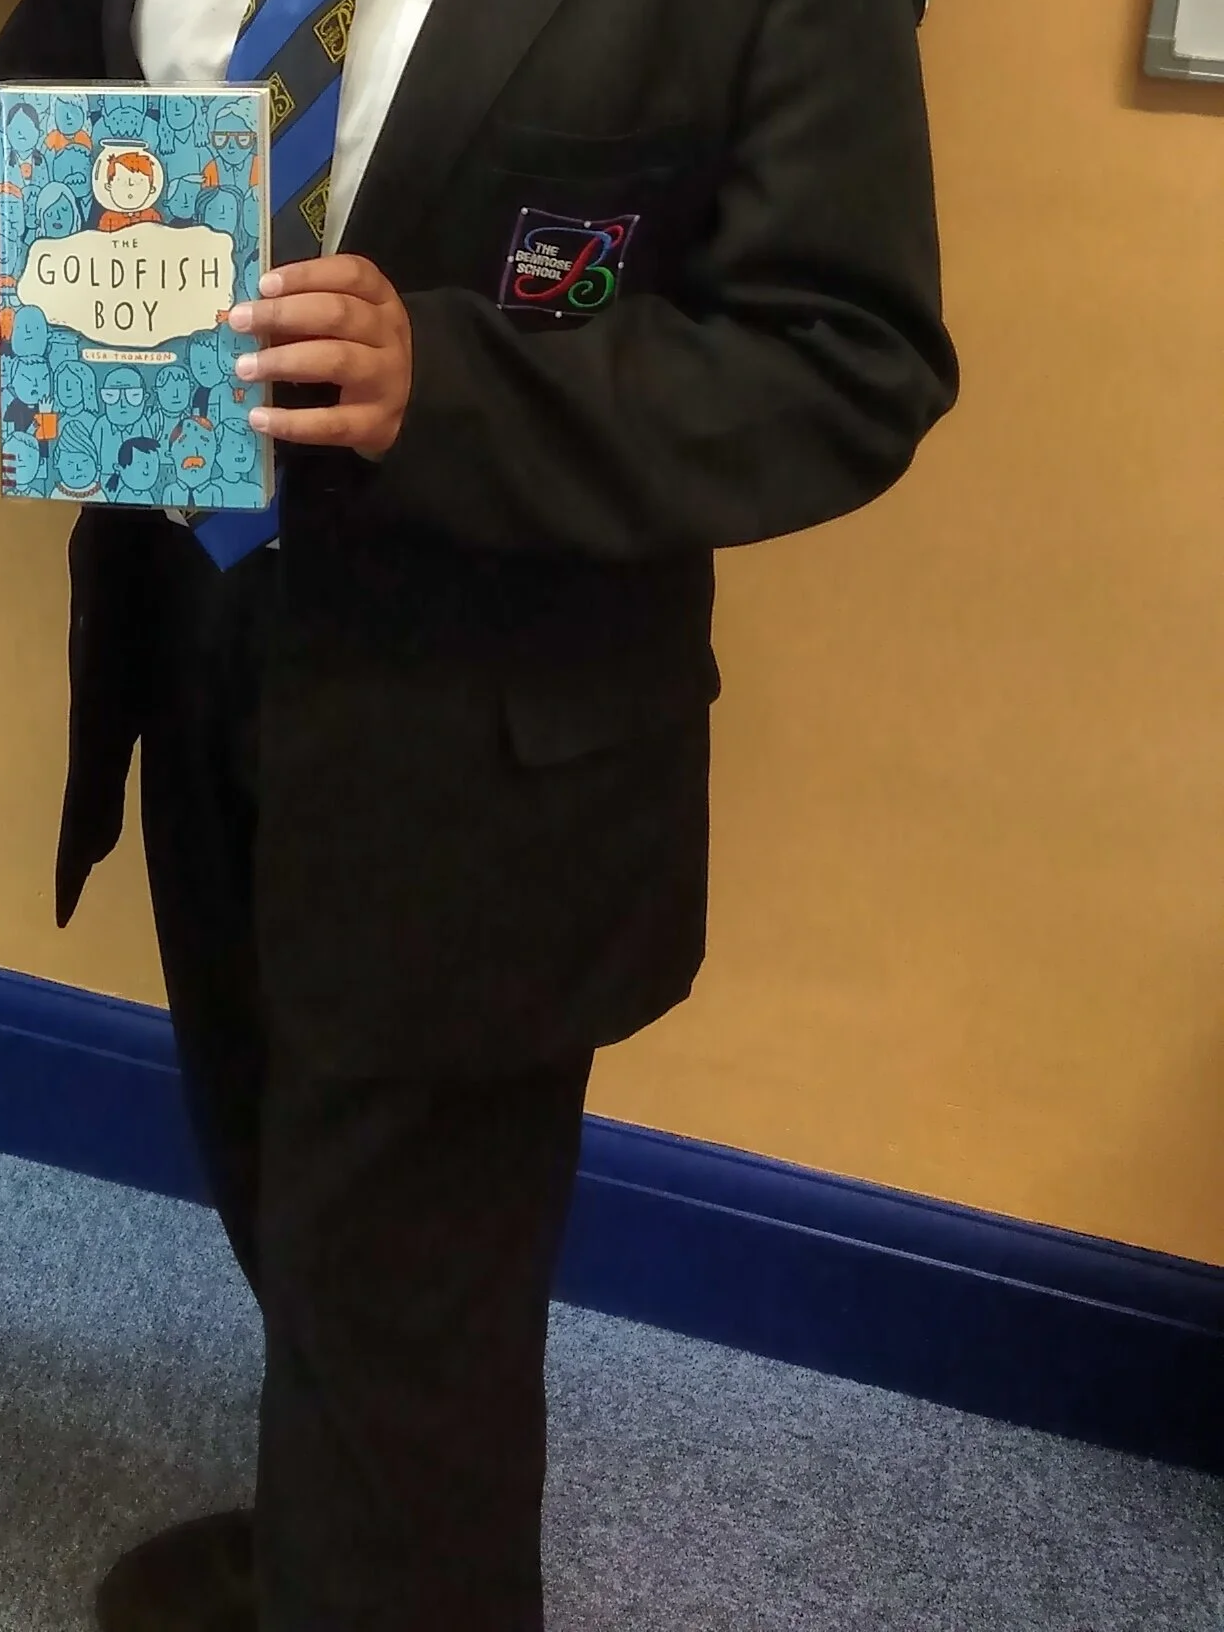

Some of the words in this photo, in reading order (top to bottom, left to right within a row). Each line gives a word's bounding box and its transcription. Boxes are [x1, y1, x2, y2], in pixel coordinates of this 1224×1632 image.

[111, 238, 139, 249] THE
[534, 241, 560, 257] THE
[515, 250, 573, 272] BEMROSE
[36, 253, 220, 290] GOLDFISH
[516, 263, 563, 281] SCHOOL
[94, 300, 159, 332] BOY
[85, 351, 108, 359] LISA
[114, 352, 172, 362] THOMPSON
